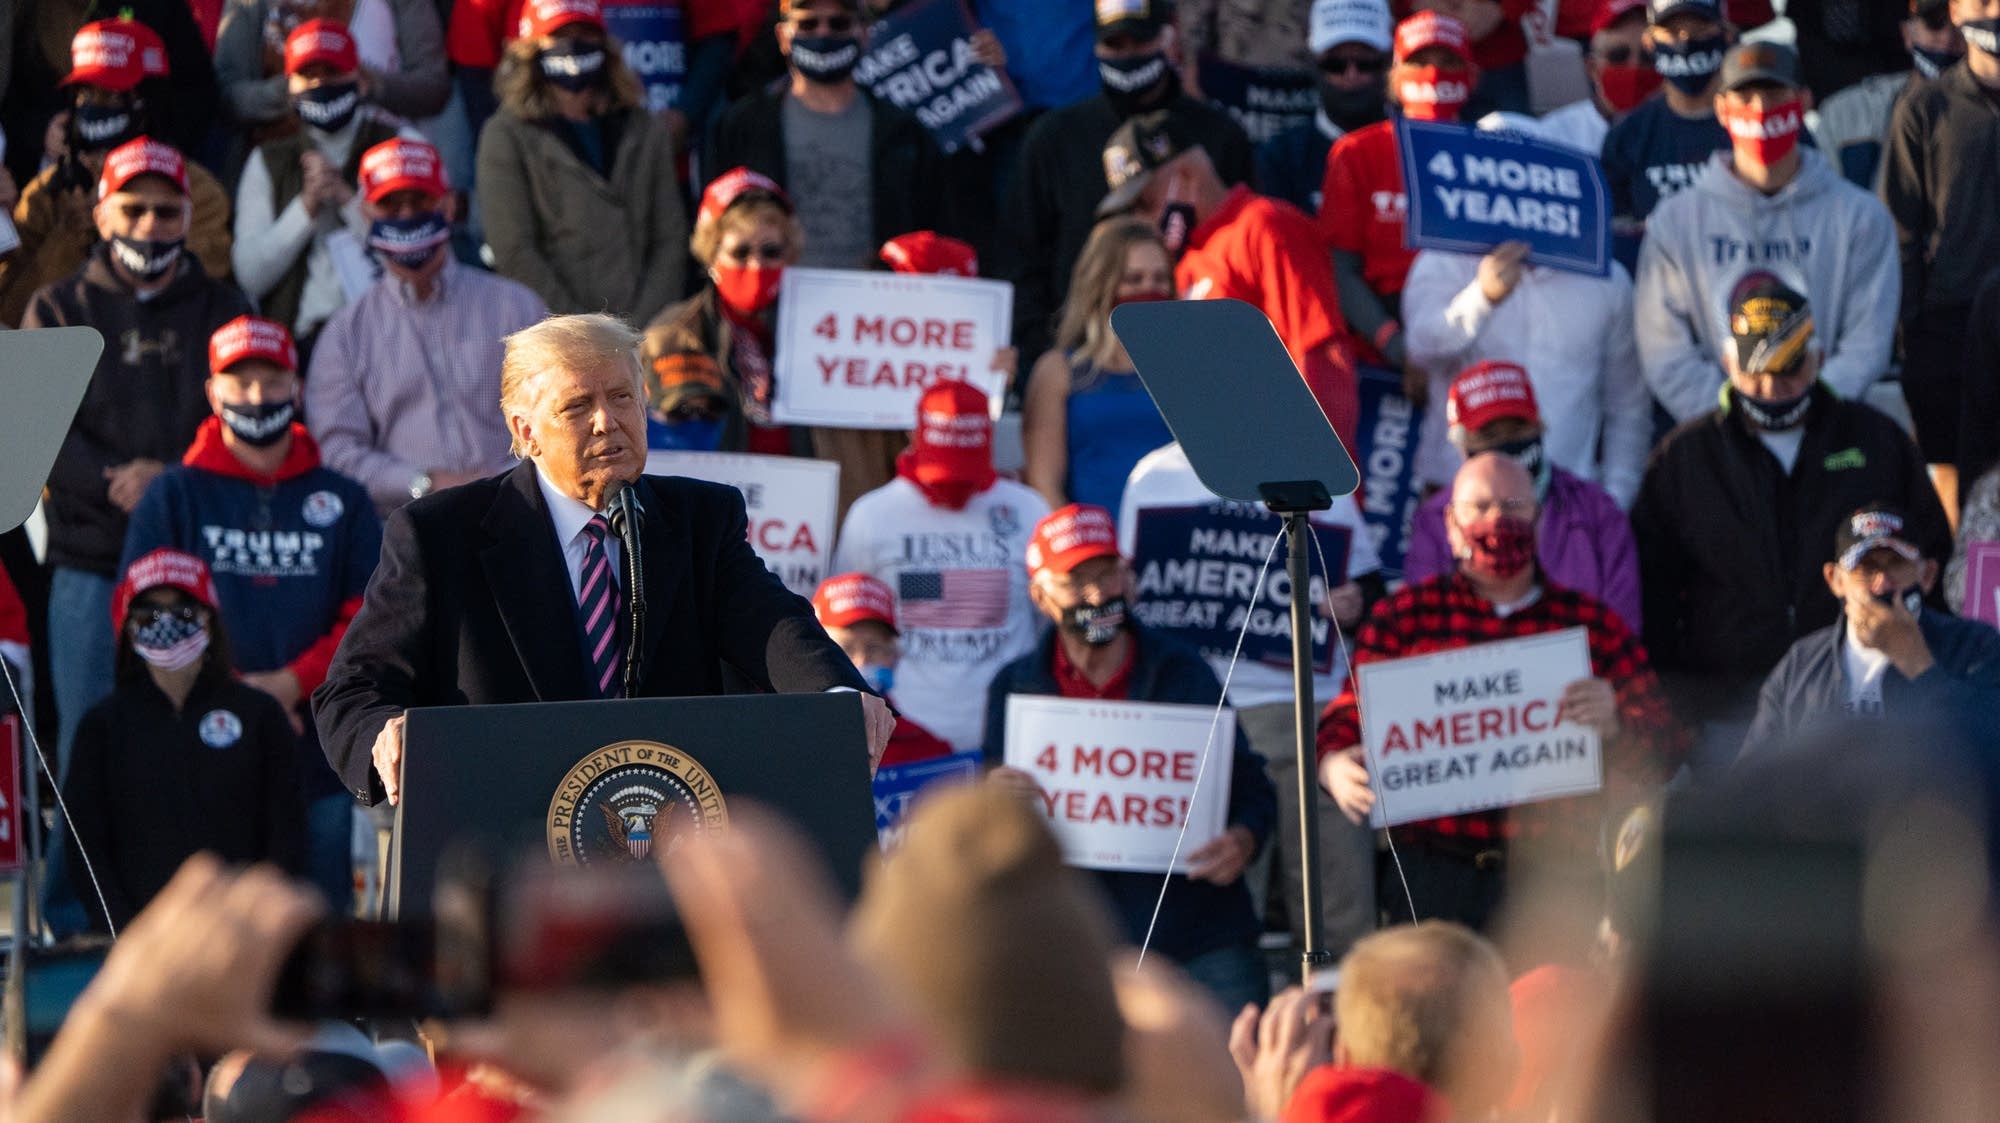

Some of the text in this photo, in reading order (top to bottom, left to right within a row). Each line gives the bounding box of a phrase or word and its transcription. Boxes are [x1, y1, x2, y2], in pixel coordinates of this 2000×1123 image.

[1427, 150, 1582, 198] 4 MORE
[1434, 185, 1581, 238] YEARS!
[813, 311, 976, 350] 4 MORE
[202, 525, 323, 553] TRUMP
[903, 533, 1010, 562] JESUS
[1190, 527, 1280, 562] MAKE
[1138, 557, 1329, 606] AMERICA
[1134, 598, 1225, 630] GREAT
[1225, 604, 1329, 645] AGAN
[1433, 668, 1523, 705] MAKE
[1035, 744, 1197, 783] 4 MORE
[1380, 735, 1586, 791] GREAT AGAIN
[553, 747, 632, 829] PRESIDENT
[636, 748, 654, 760] OF
[657, 751, 681, 769] THE
[1036, 788, 1192, 830] YEARS!
